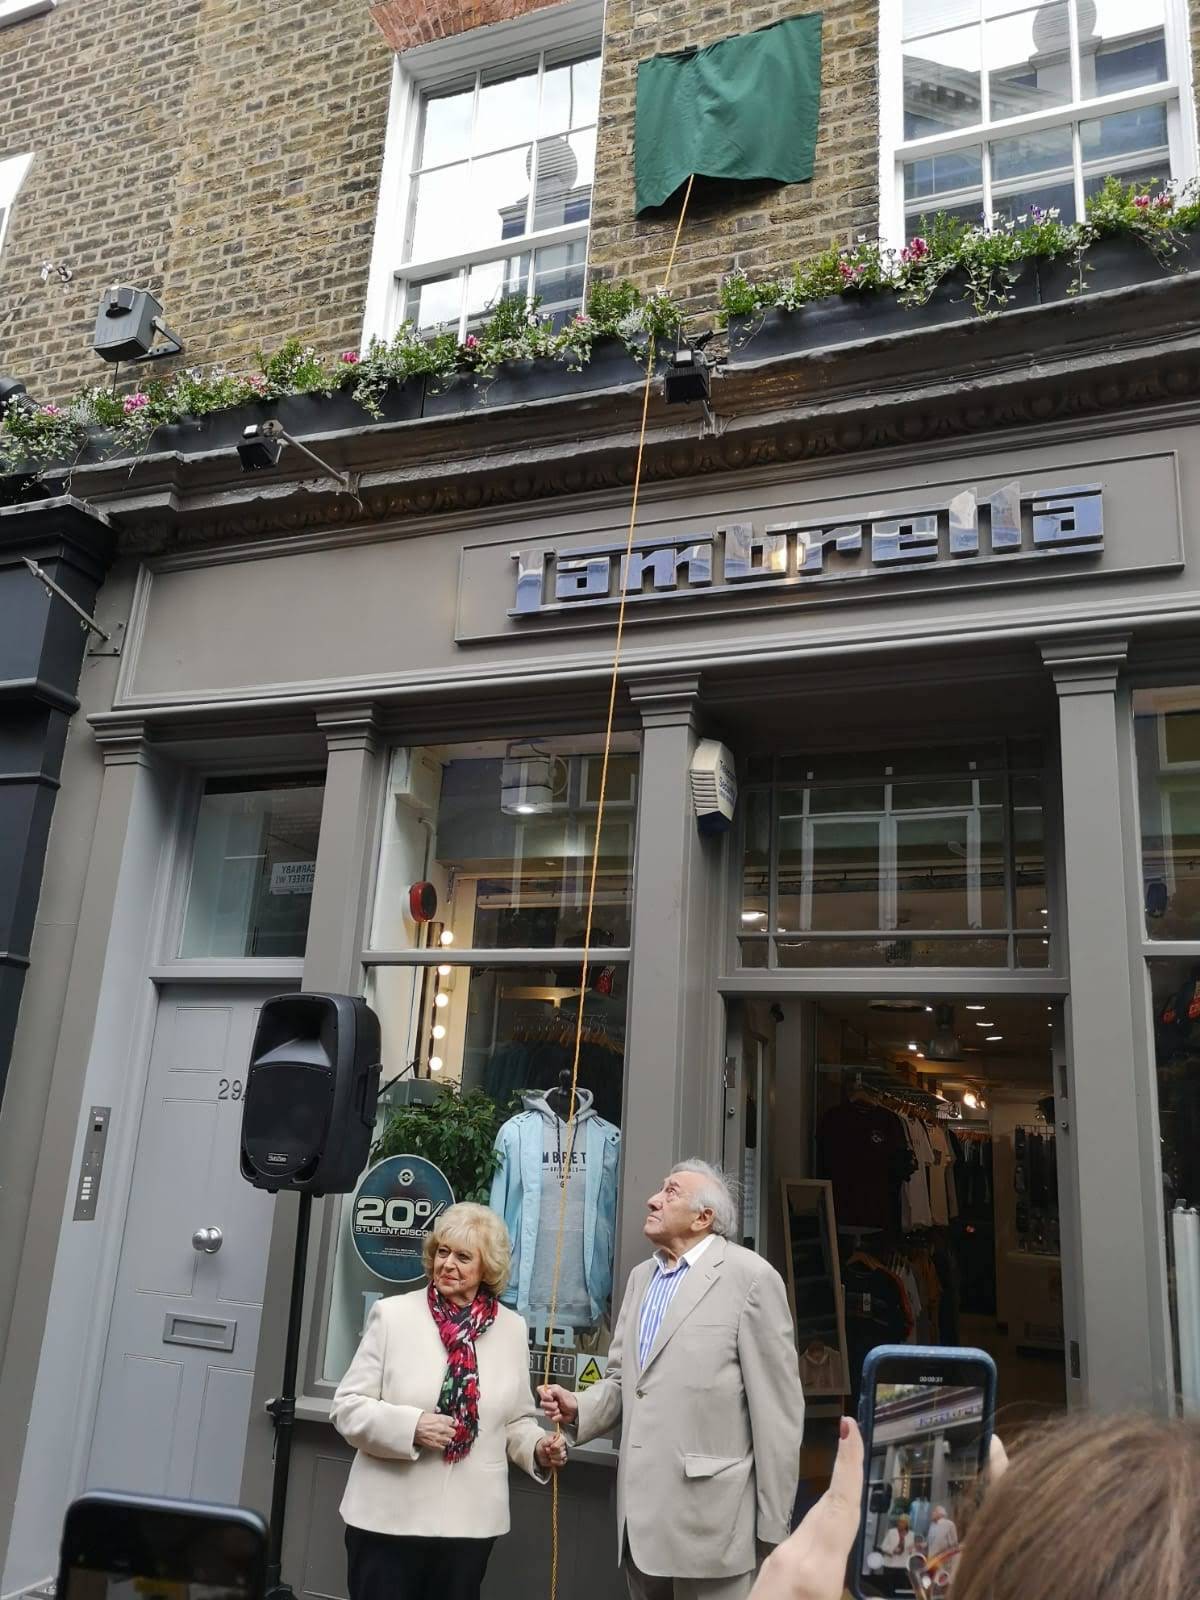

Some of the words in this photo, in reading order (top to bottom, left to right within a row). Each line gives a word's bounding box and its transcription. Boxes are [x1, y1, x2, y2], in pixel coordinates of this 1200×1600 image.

[217, 1078, 245, 1101] 29
[355, 1196, 447, 1230] 20%
[355, 1225, 399, 1236] STUDENT
[400, 1228, 433, 1237] DISCO
[528, 1353, 574, 1375] STEET
